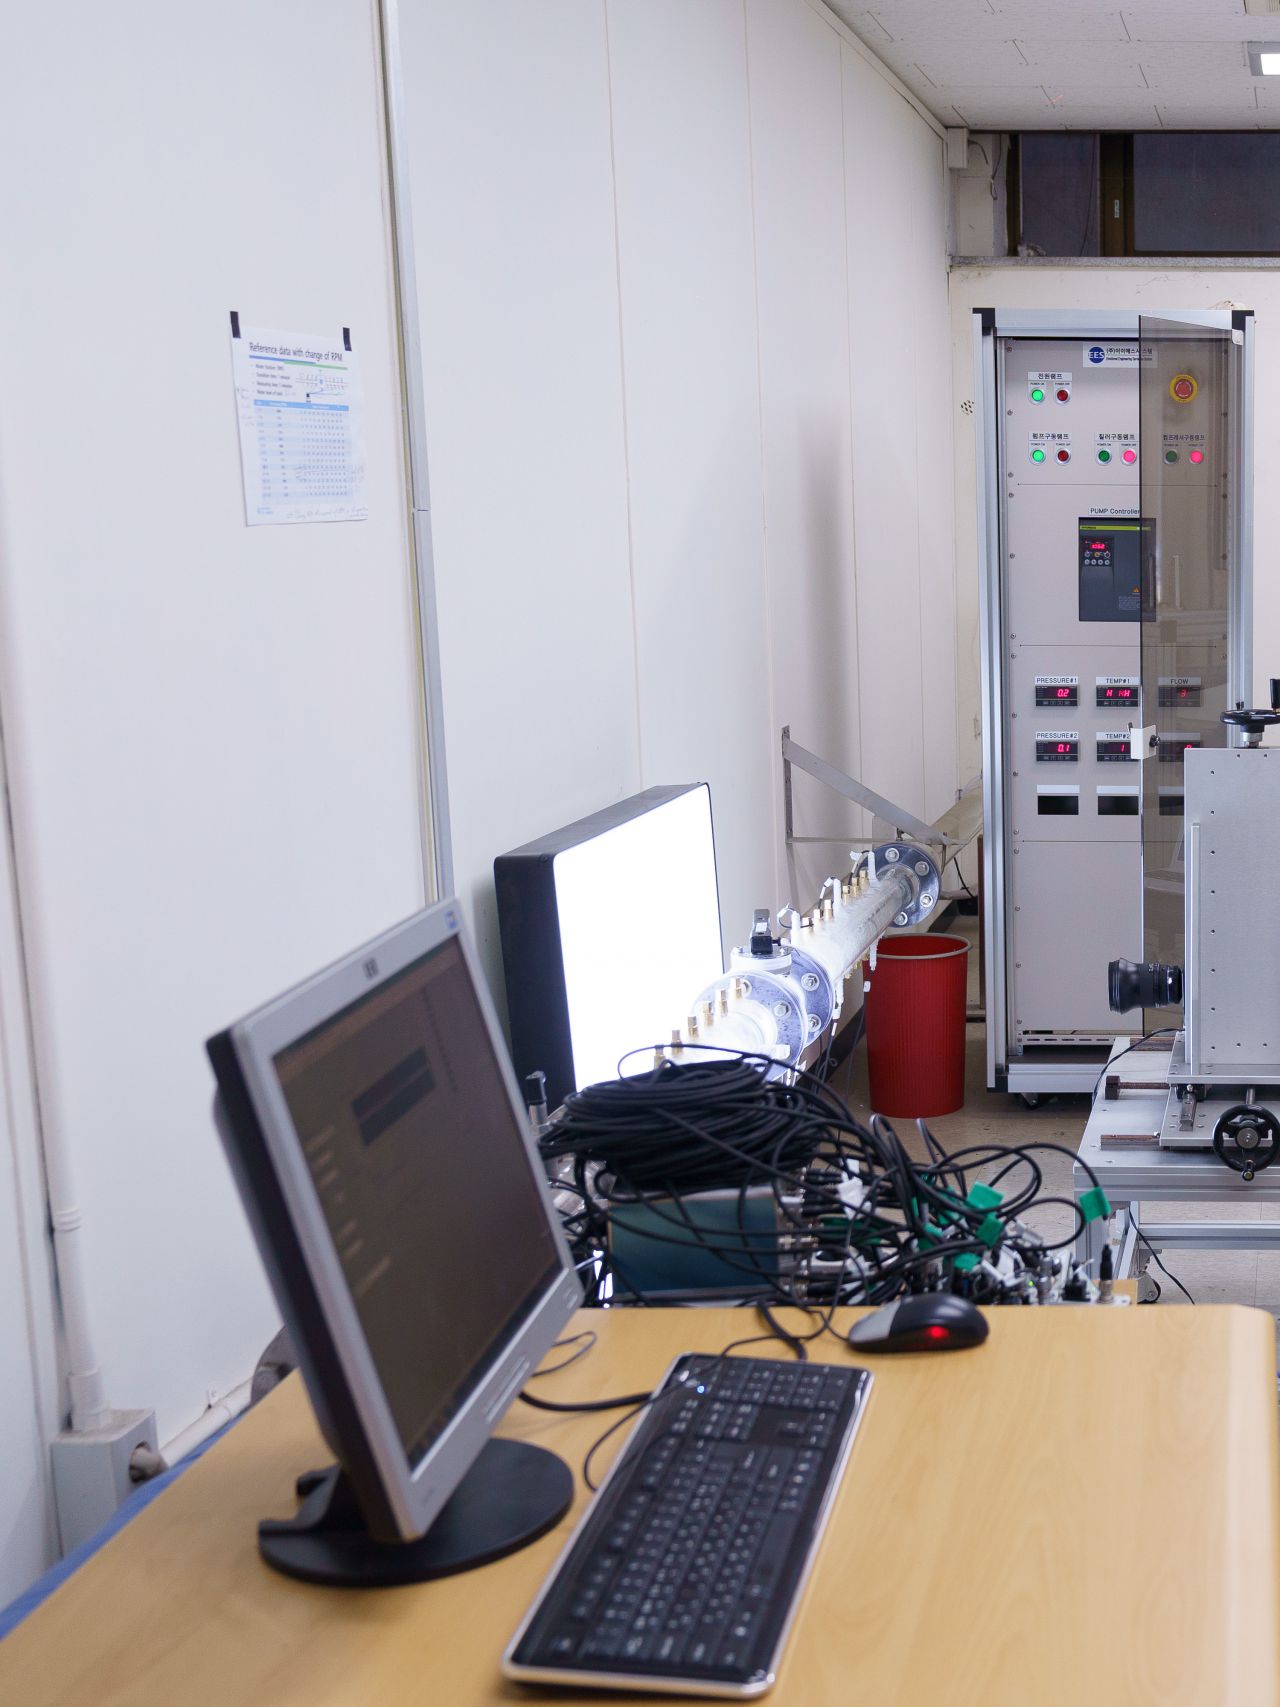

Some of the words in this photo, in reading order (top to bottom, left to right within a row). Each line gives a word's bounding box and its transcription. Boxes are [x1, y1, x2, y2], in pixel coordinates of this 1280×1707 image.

[249, 342, 278, 355] Reference
[279, 345, 291, 355] data
[292, 346, 304, 357] with
[305, 348, 323, 361] change
[331, 352, 343, 361] RPM
[1089, 351, 1105, 359] EES
